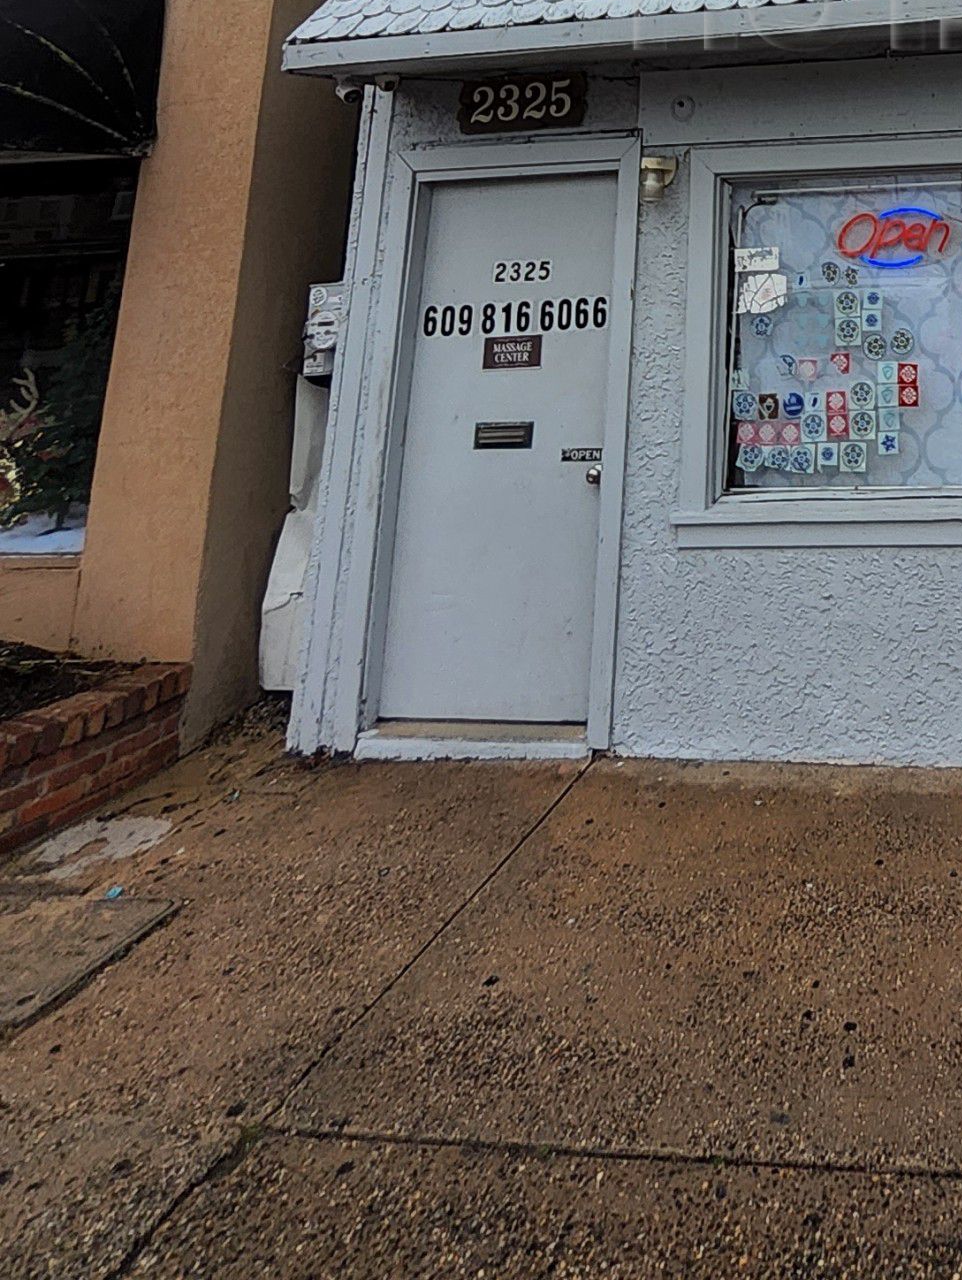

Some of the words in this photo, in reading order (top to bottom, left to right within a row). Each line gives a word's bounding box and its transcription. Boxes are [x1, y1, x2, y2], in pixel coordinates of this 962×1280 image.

[470, 79, 571, 123] 2325
[838, 212, 950, 259] Open
[494, 261, 551, 283] 2325
[423, 304, 474, 337] 609
[481, 300, 531, 334] 816
[540, 296, 608, 332] 6066
[493, 341, 533, 353] MASSAGE
[494, 352, 530, 363] CENTER
[570, 449, 601, 460] OPEN
